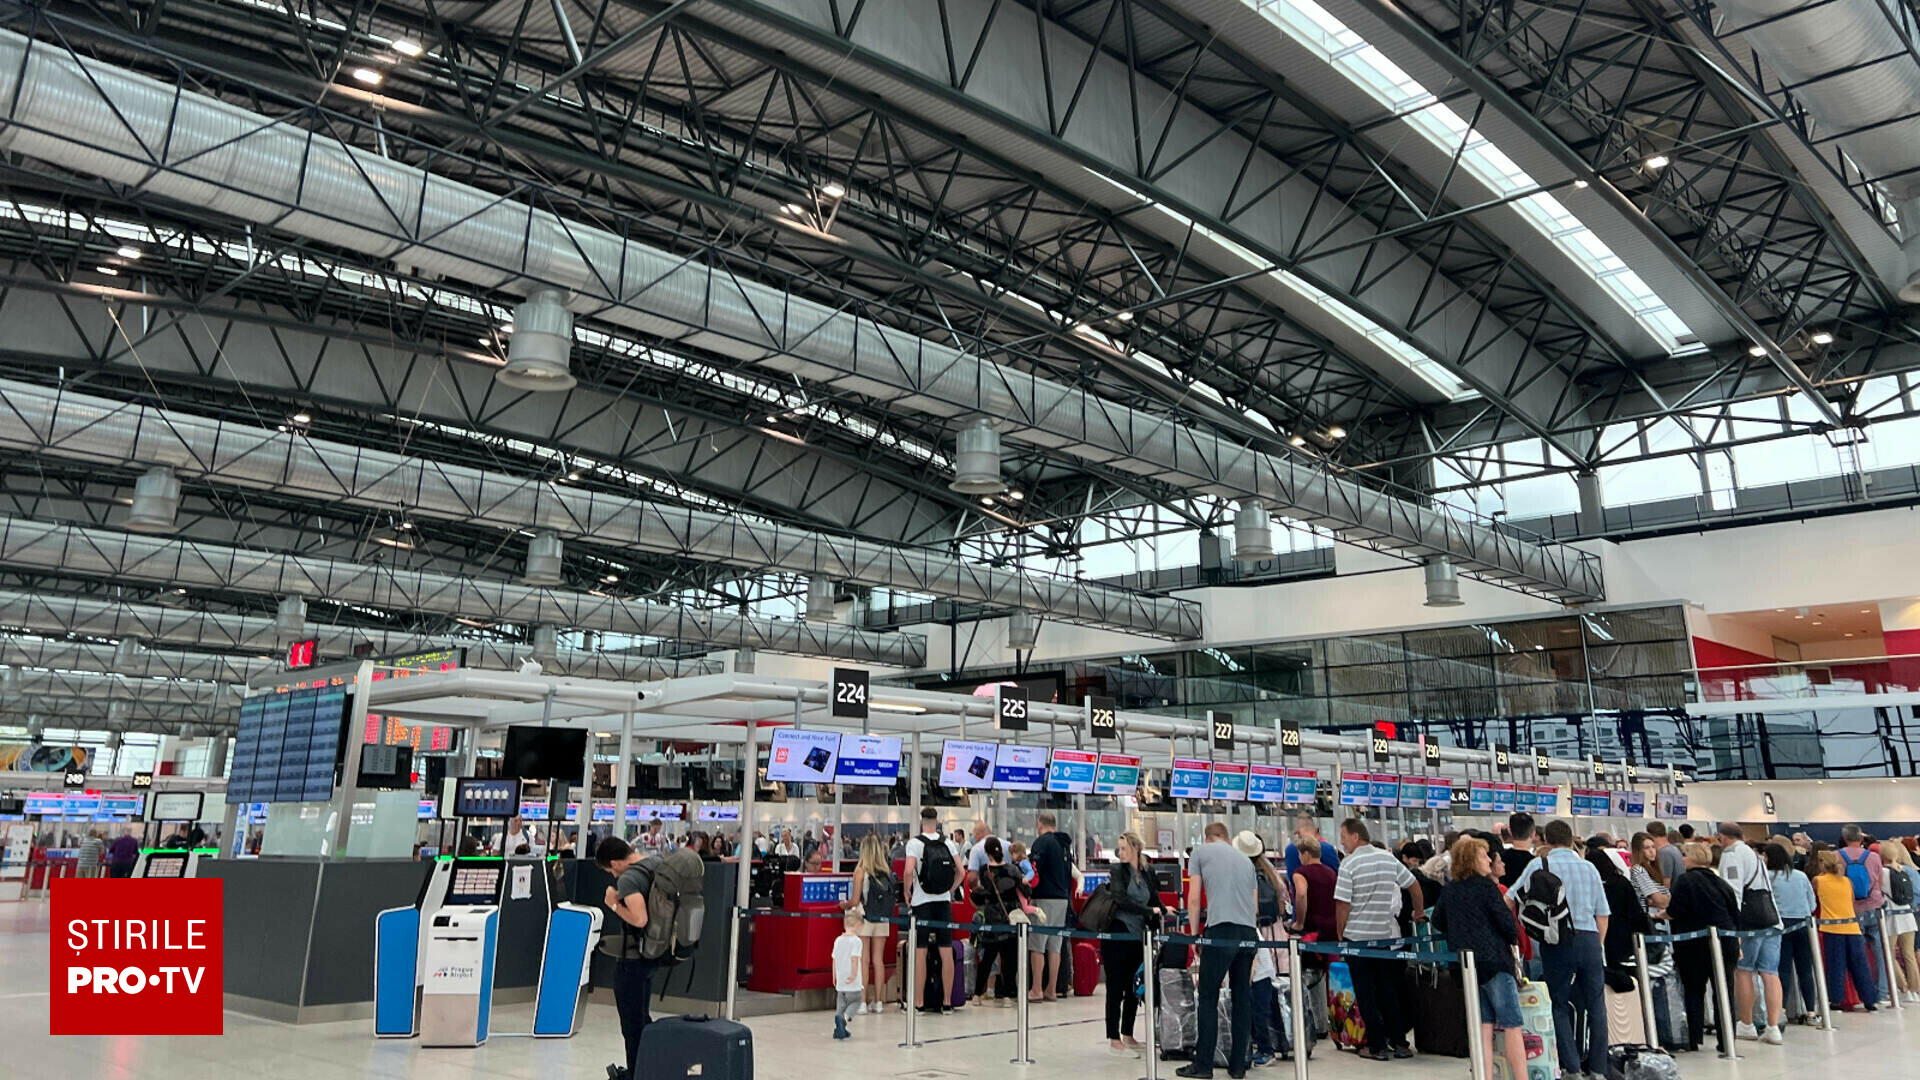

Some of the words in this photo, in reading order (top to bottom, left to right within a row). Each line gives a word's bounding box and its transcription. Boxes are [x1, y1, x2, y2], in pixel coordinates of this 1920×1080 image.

[837, 682, 865, 704] 224
[1002, 698, 1026, 719] 225
[1092, 709, 1114, 728] 226
[1215, 722, 1232, 739] 227
[1282, 729, 1299, 746] 228
[1373, 738, 1388, 753] 229
[133, 775, 151, 786] 250
